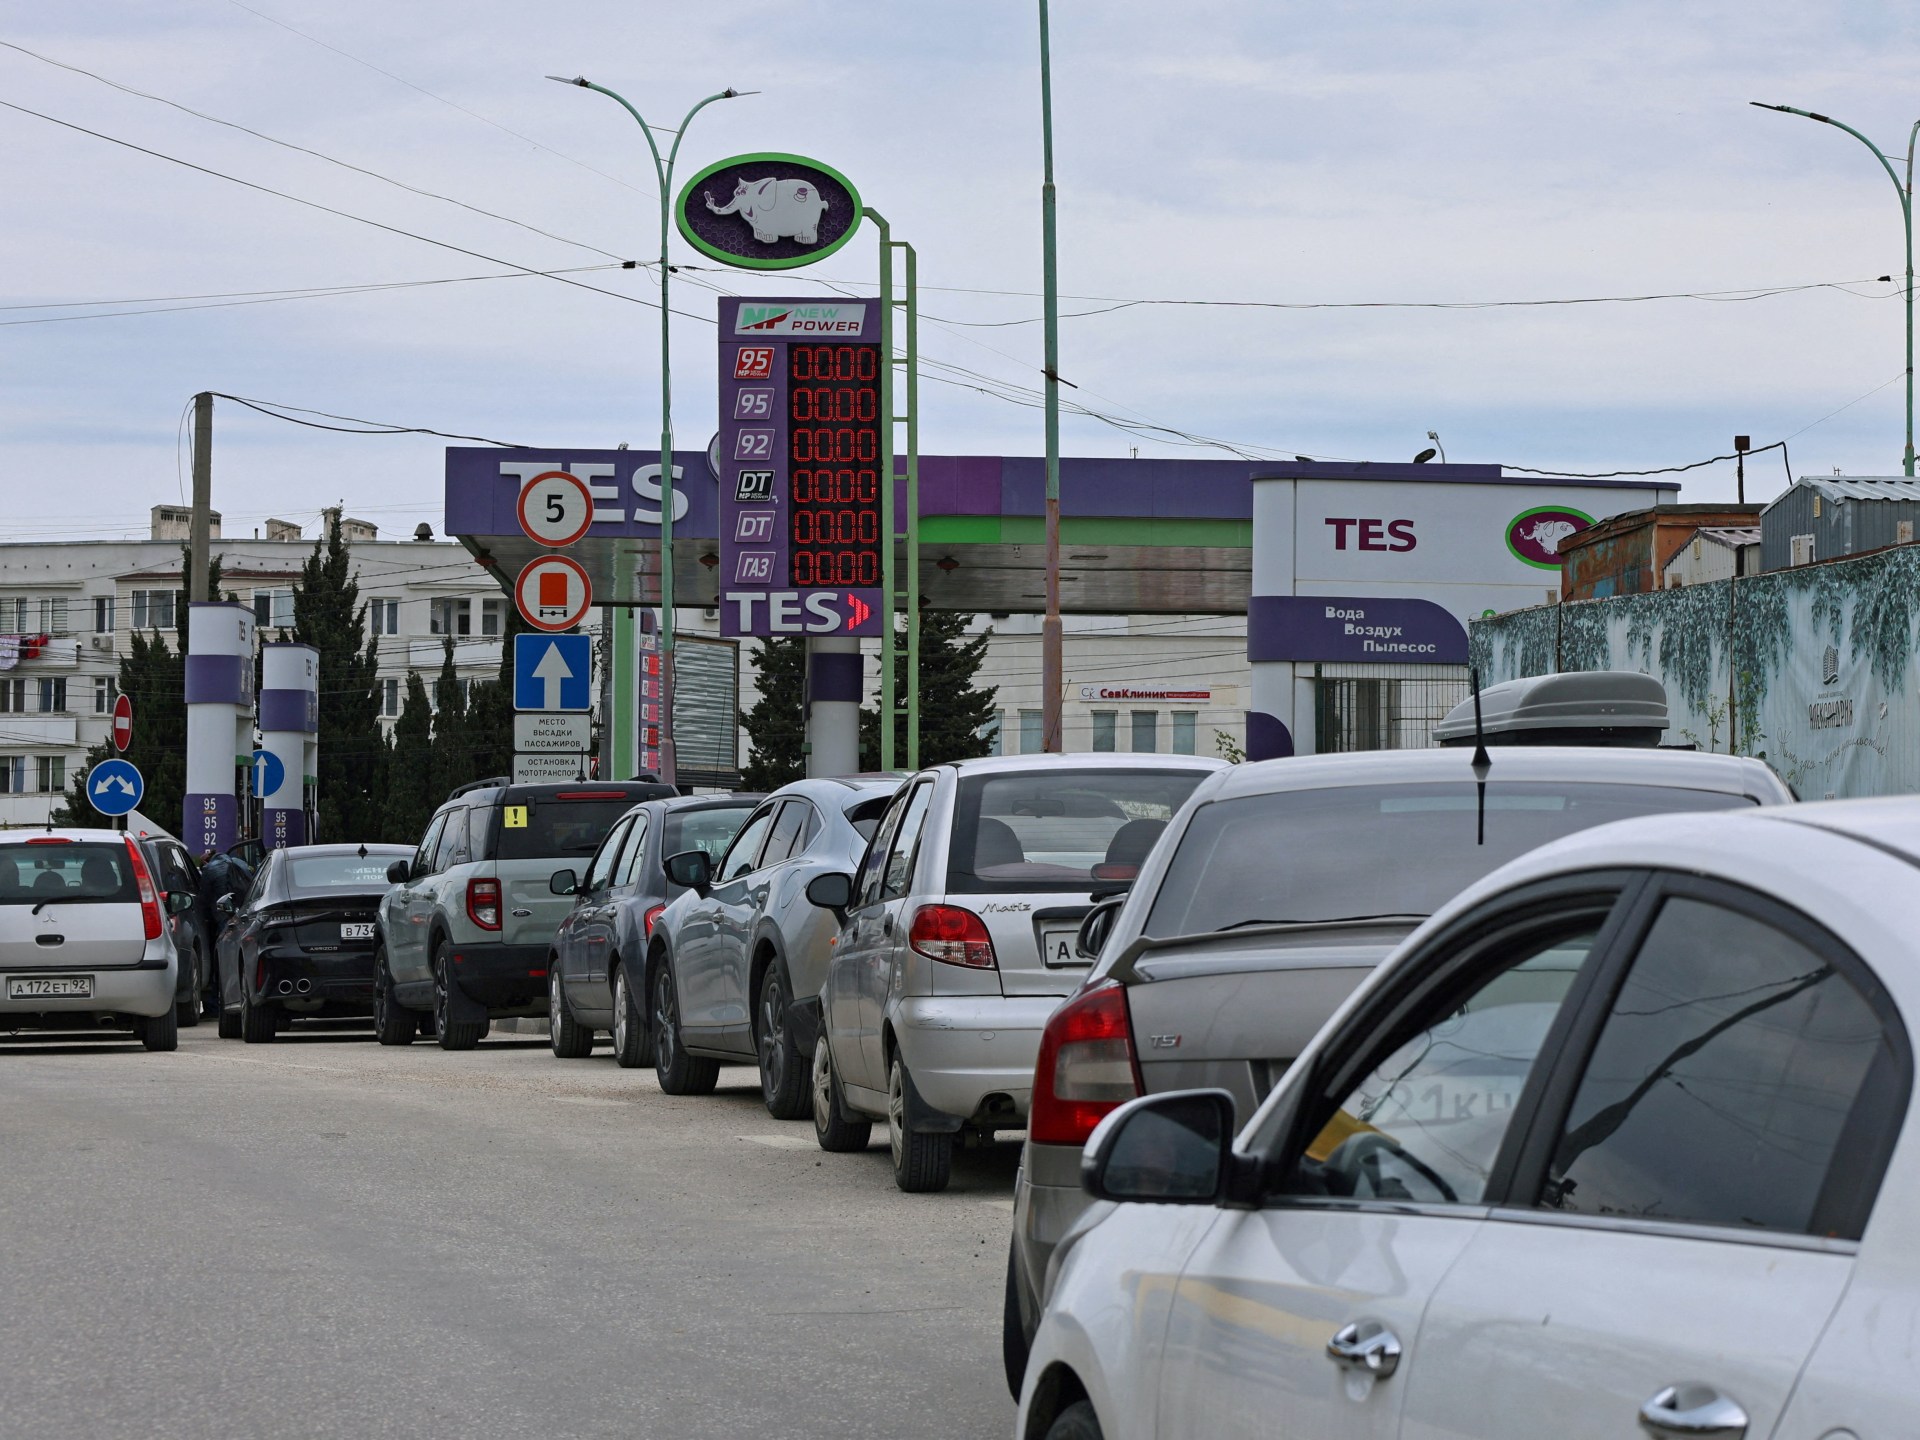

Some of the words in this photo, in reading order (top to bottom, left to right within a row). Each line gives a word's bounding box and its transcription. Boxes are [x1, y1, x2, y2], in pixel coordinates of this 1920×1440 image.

[794, 308, 839, 318] NEW
[792, 321, 859, 331] POWER
[741, 350, 768, 370] 95
[741, 394, 768, 414] 95
[741, 435, 768, 454] 92
[740, 473, 771, 492] DT
[546, 494, 565, 523] 5
[740, 517, 770, 536] DT
[1325, 518, 1417, 552] TES
[742, 558, 769, 577] ГАЗ
[726, 592, 841, 632] TES
[1325, 606, 1365, 621] Вода
[1344, 623, 1402, 638] Воздух
[1363, 640, 1436, 653] Пылесос
[1100, 688, 1167, 699] СевКлиник
[524, 740, 581, 748] ПАССАЖИРОВ
[203, 798, 216, 810] 95
[204, 817, 217, 829] 95
[275, 812, 287, 823] 95
[204, 832, 216, 845] 92
[275, 827, 287, 838] 95
[979, 902, 1031, 914] Matiz
